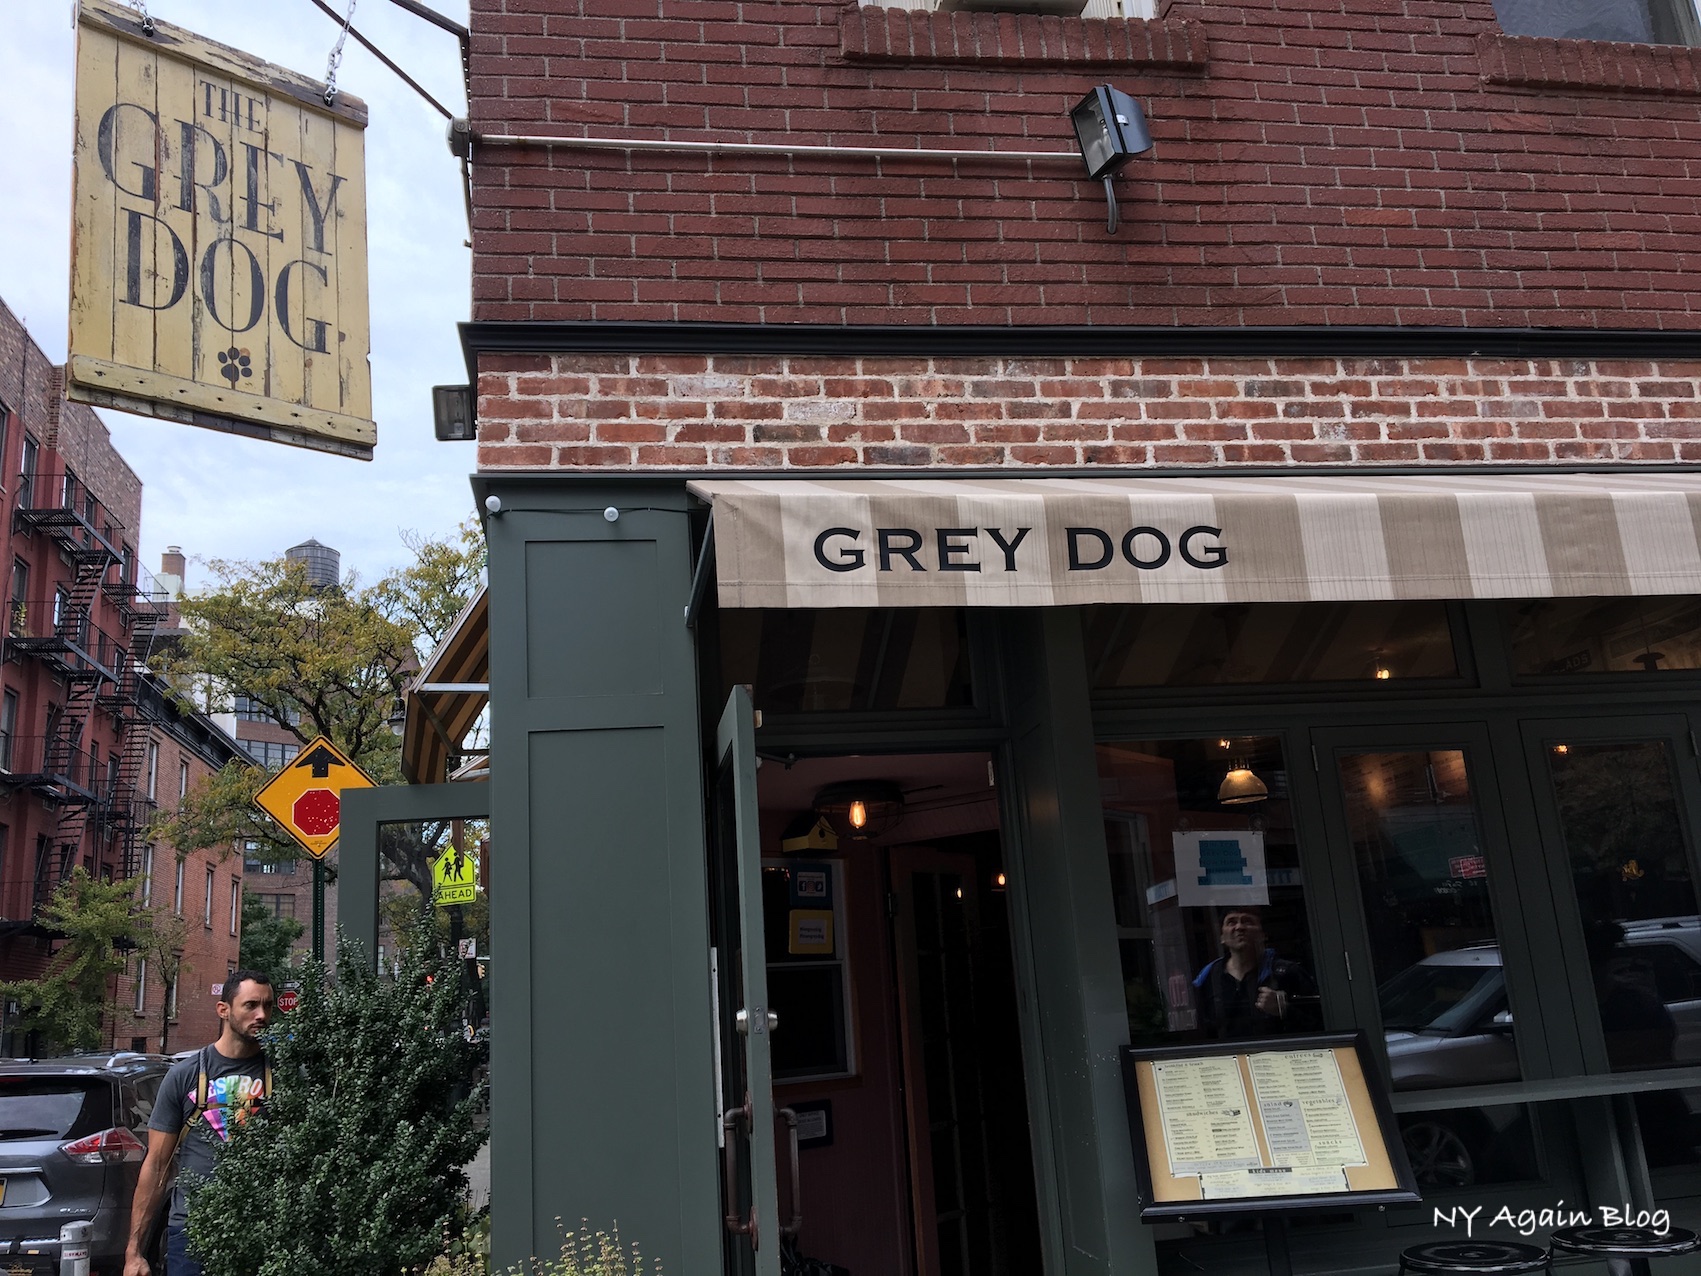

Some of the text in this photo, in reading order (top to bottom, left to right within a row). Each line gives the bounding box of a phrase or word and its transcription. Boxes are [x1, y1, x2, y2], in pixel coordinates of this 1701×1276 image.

[199, 80, 265, 134] THE
[97, 103, 348, 256] GREY
[118, 206, 333, 355] DOG
[812, 525, 1230, 572] GREY DOG
[438, 888, 472, 900] AHEAD
[279, 997, 299, 1007] STOP
